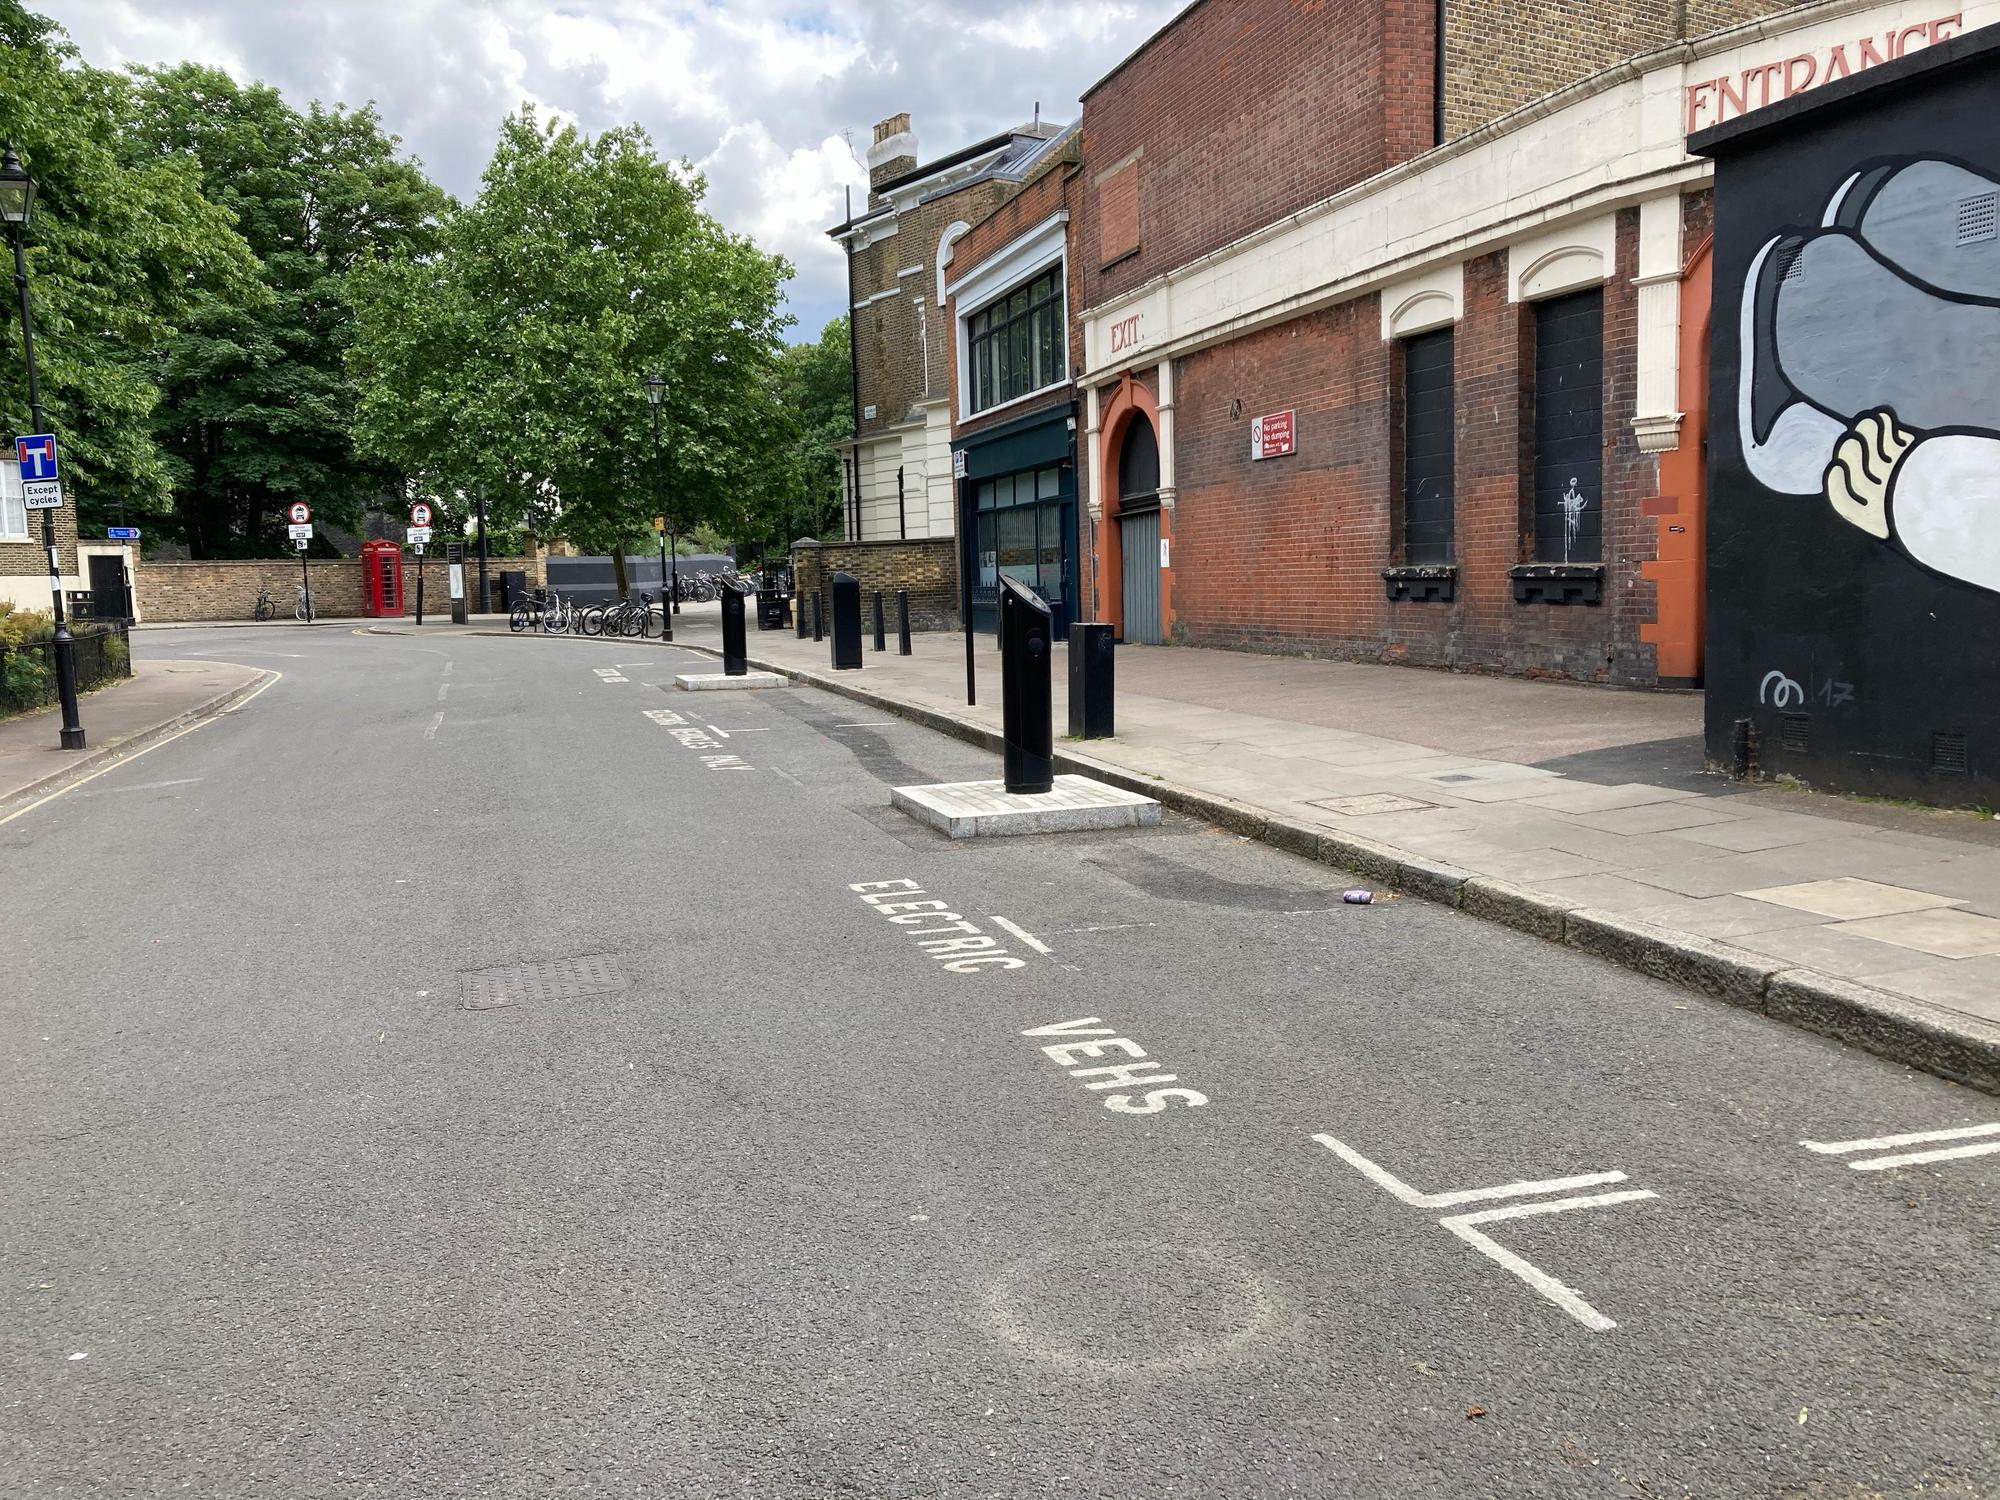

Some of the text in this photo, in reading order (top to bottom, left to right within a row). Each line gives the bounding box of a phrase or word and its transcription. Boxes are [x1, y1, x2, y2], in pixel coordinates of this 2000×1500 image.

[1264, 420, 1287, 432] No parking
[1264, 430, 1290, 442] No dumping
[27, 485, 58, 495] Except
[30, 496, 58, 506] cycles
[848, 878, 1209, 1115] ELECTRIC VEHS
